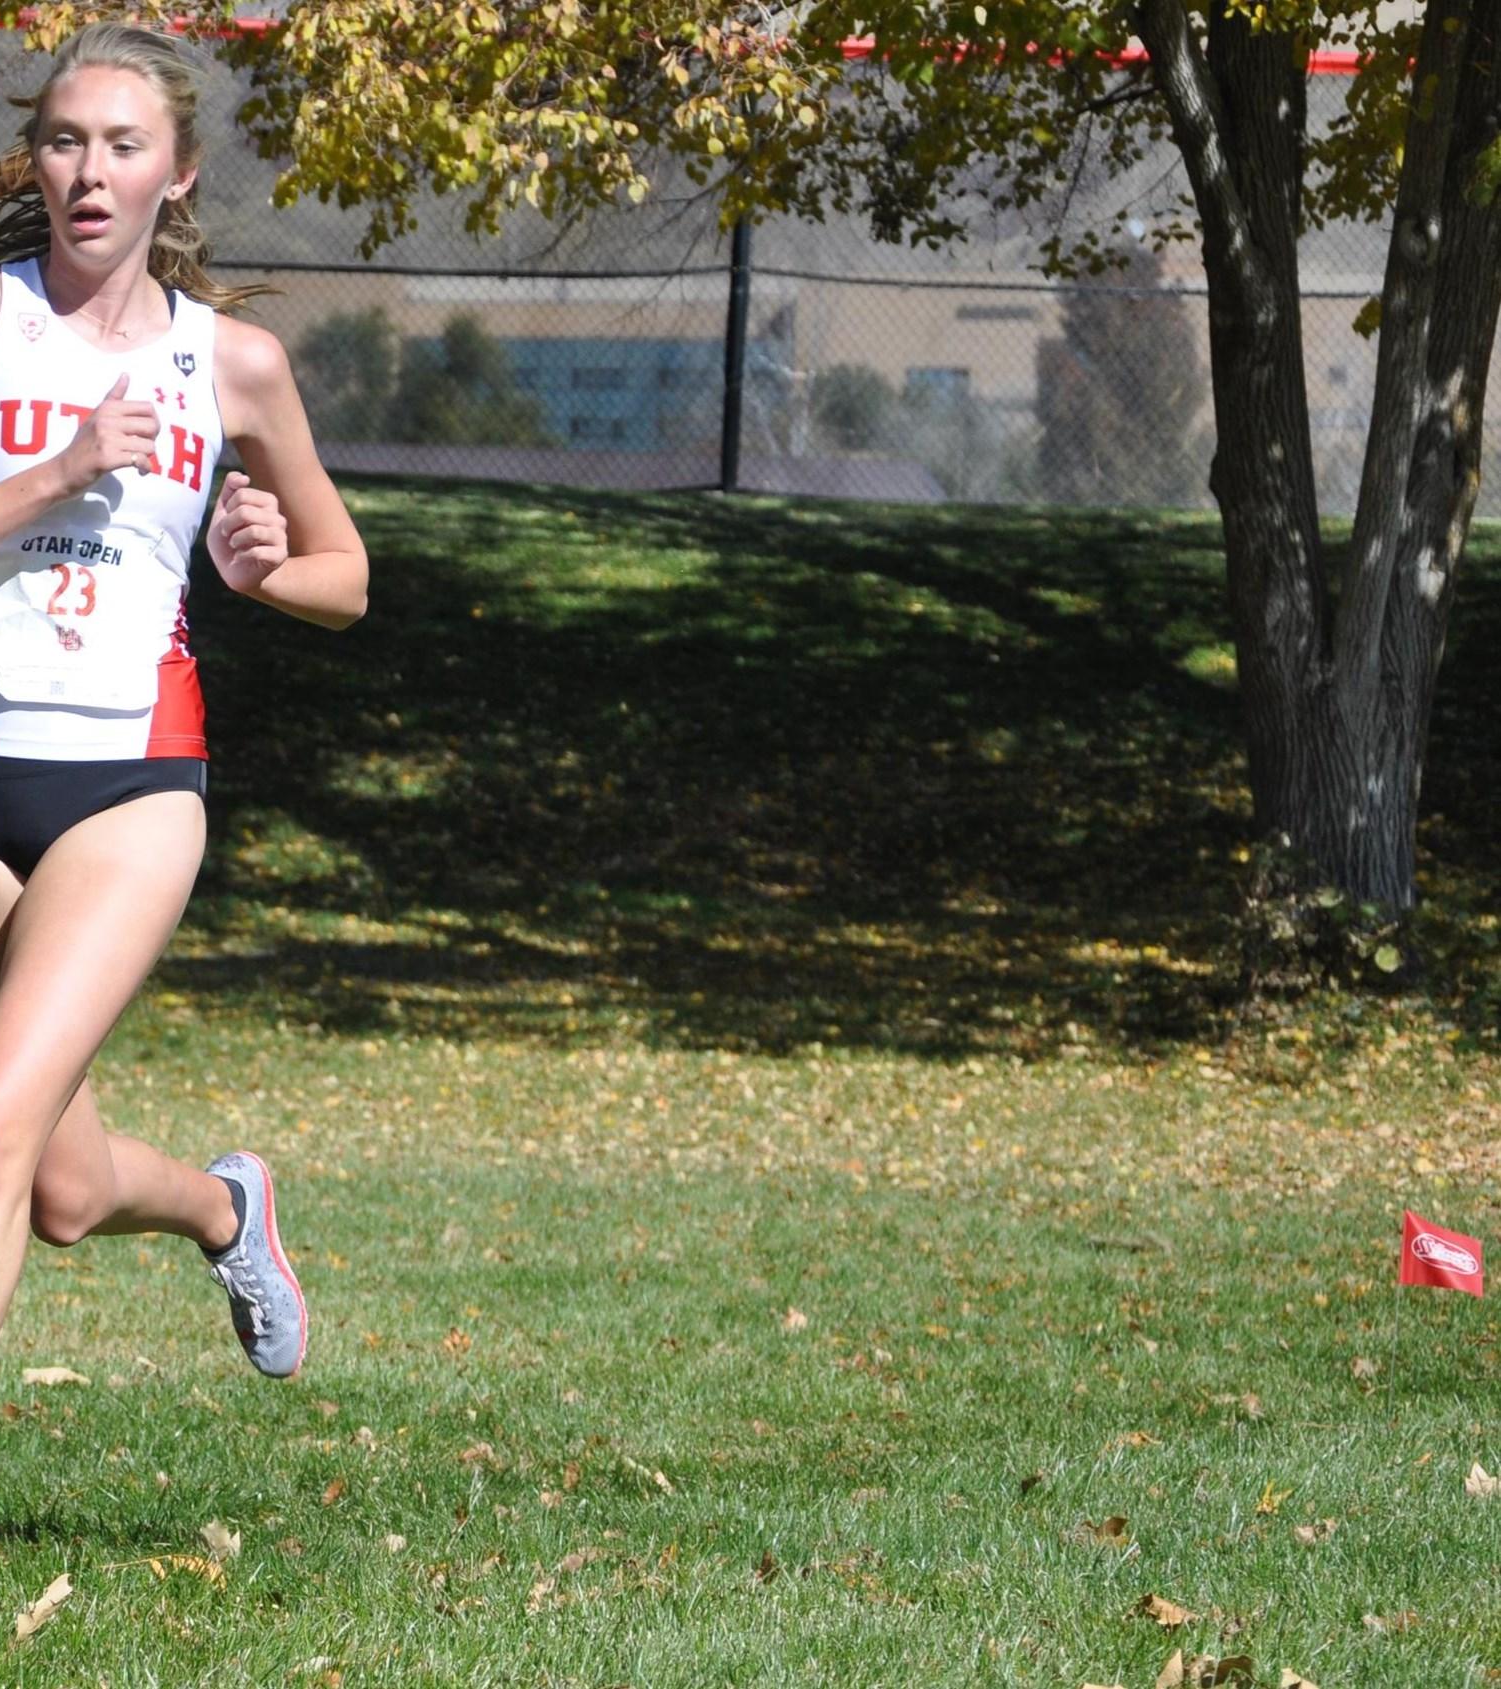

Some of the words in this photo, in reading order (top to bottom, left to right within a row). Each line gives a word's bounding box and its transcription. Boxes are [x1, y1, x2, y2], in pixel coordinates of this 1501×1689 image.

[0, 399, 205, 493] UH
[21, 536, 73, 555] UTAH
[78, 540, 123, 566] OPEN
[47, 563, 97, 617] 23
